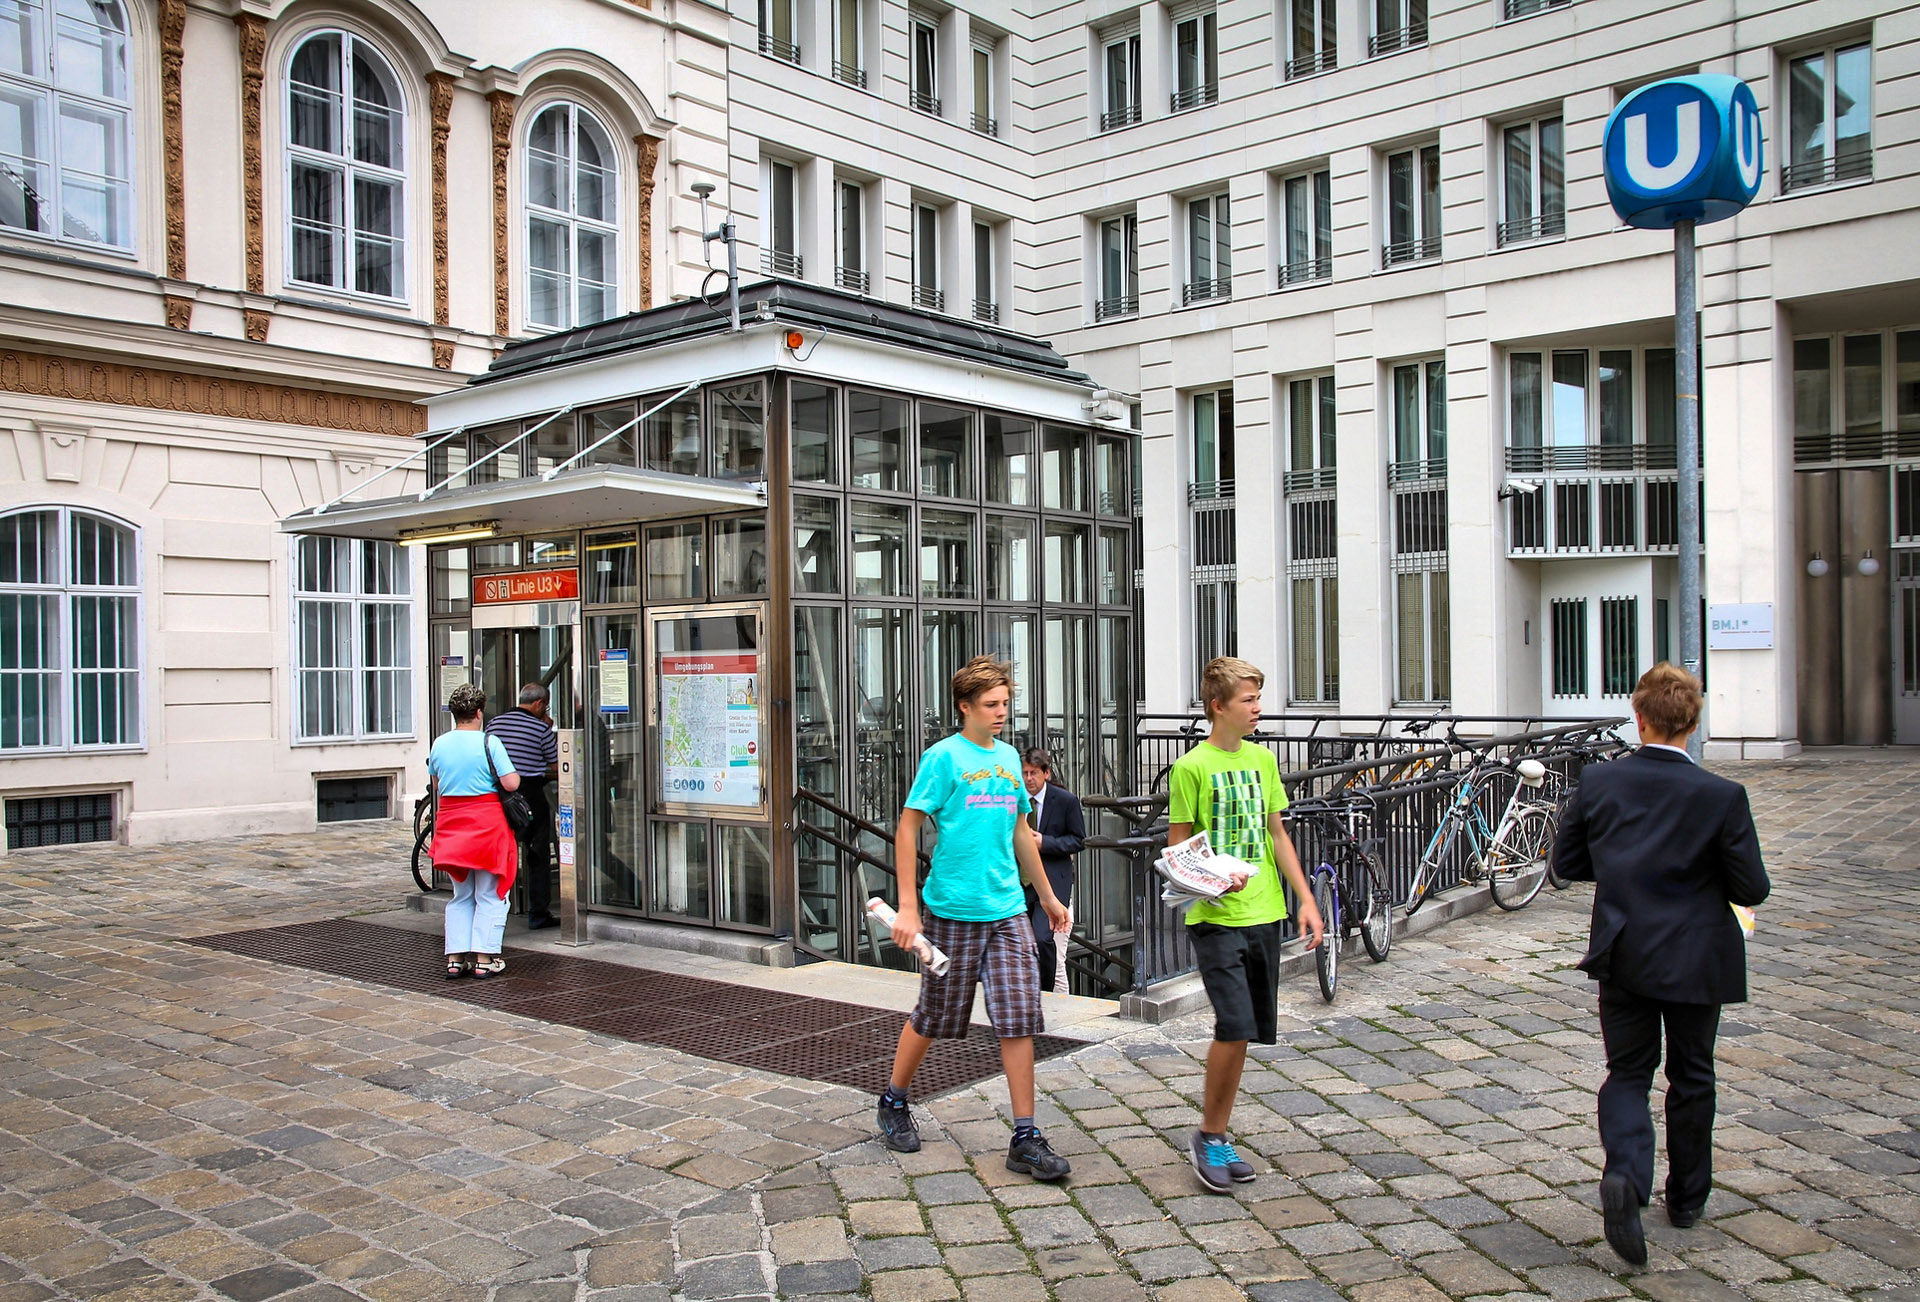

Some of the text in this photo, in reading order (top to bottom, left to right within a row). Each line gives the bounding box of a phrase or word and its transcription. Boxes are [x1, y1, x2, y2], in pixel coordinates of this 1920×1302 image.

[1624, 100, 1701, 190] U
[1734, 100, 1759, 189] U
[510, 576, 552, 595] Linie U3
[674, 662, 714, 672] Umgebungsplan
[730, 745, 748, 756] Club
